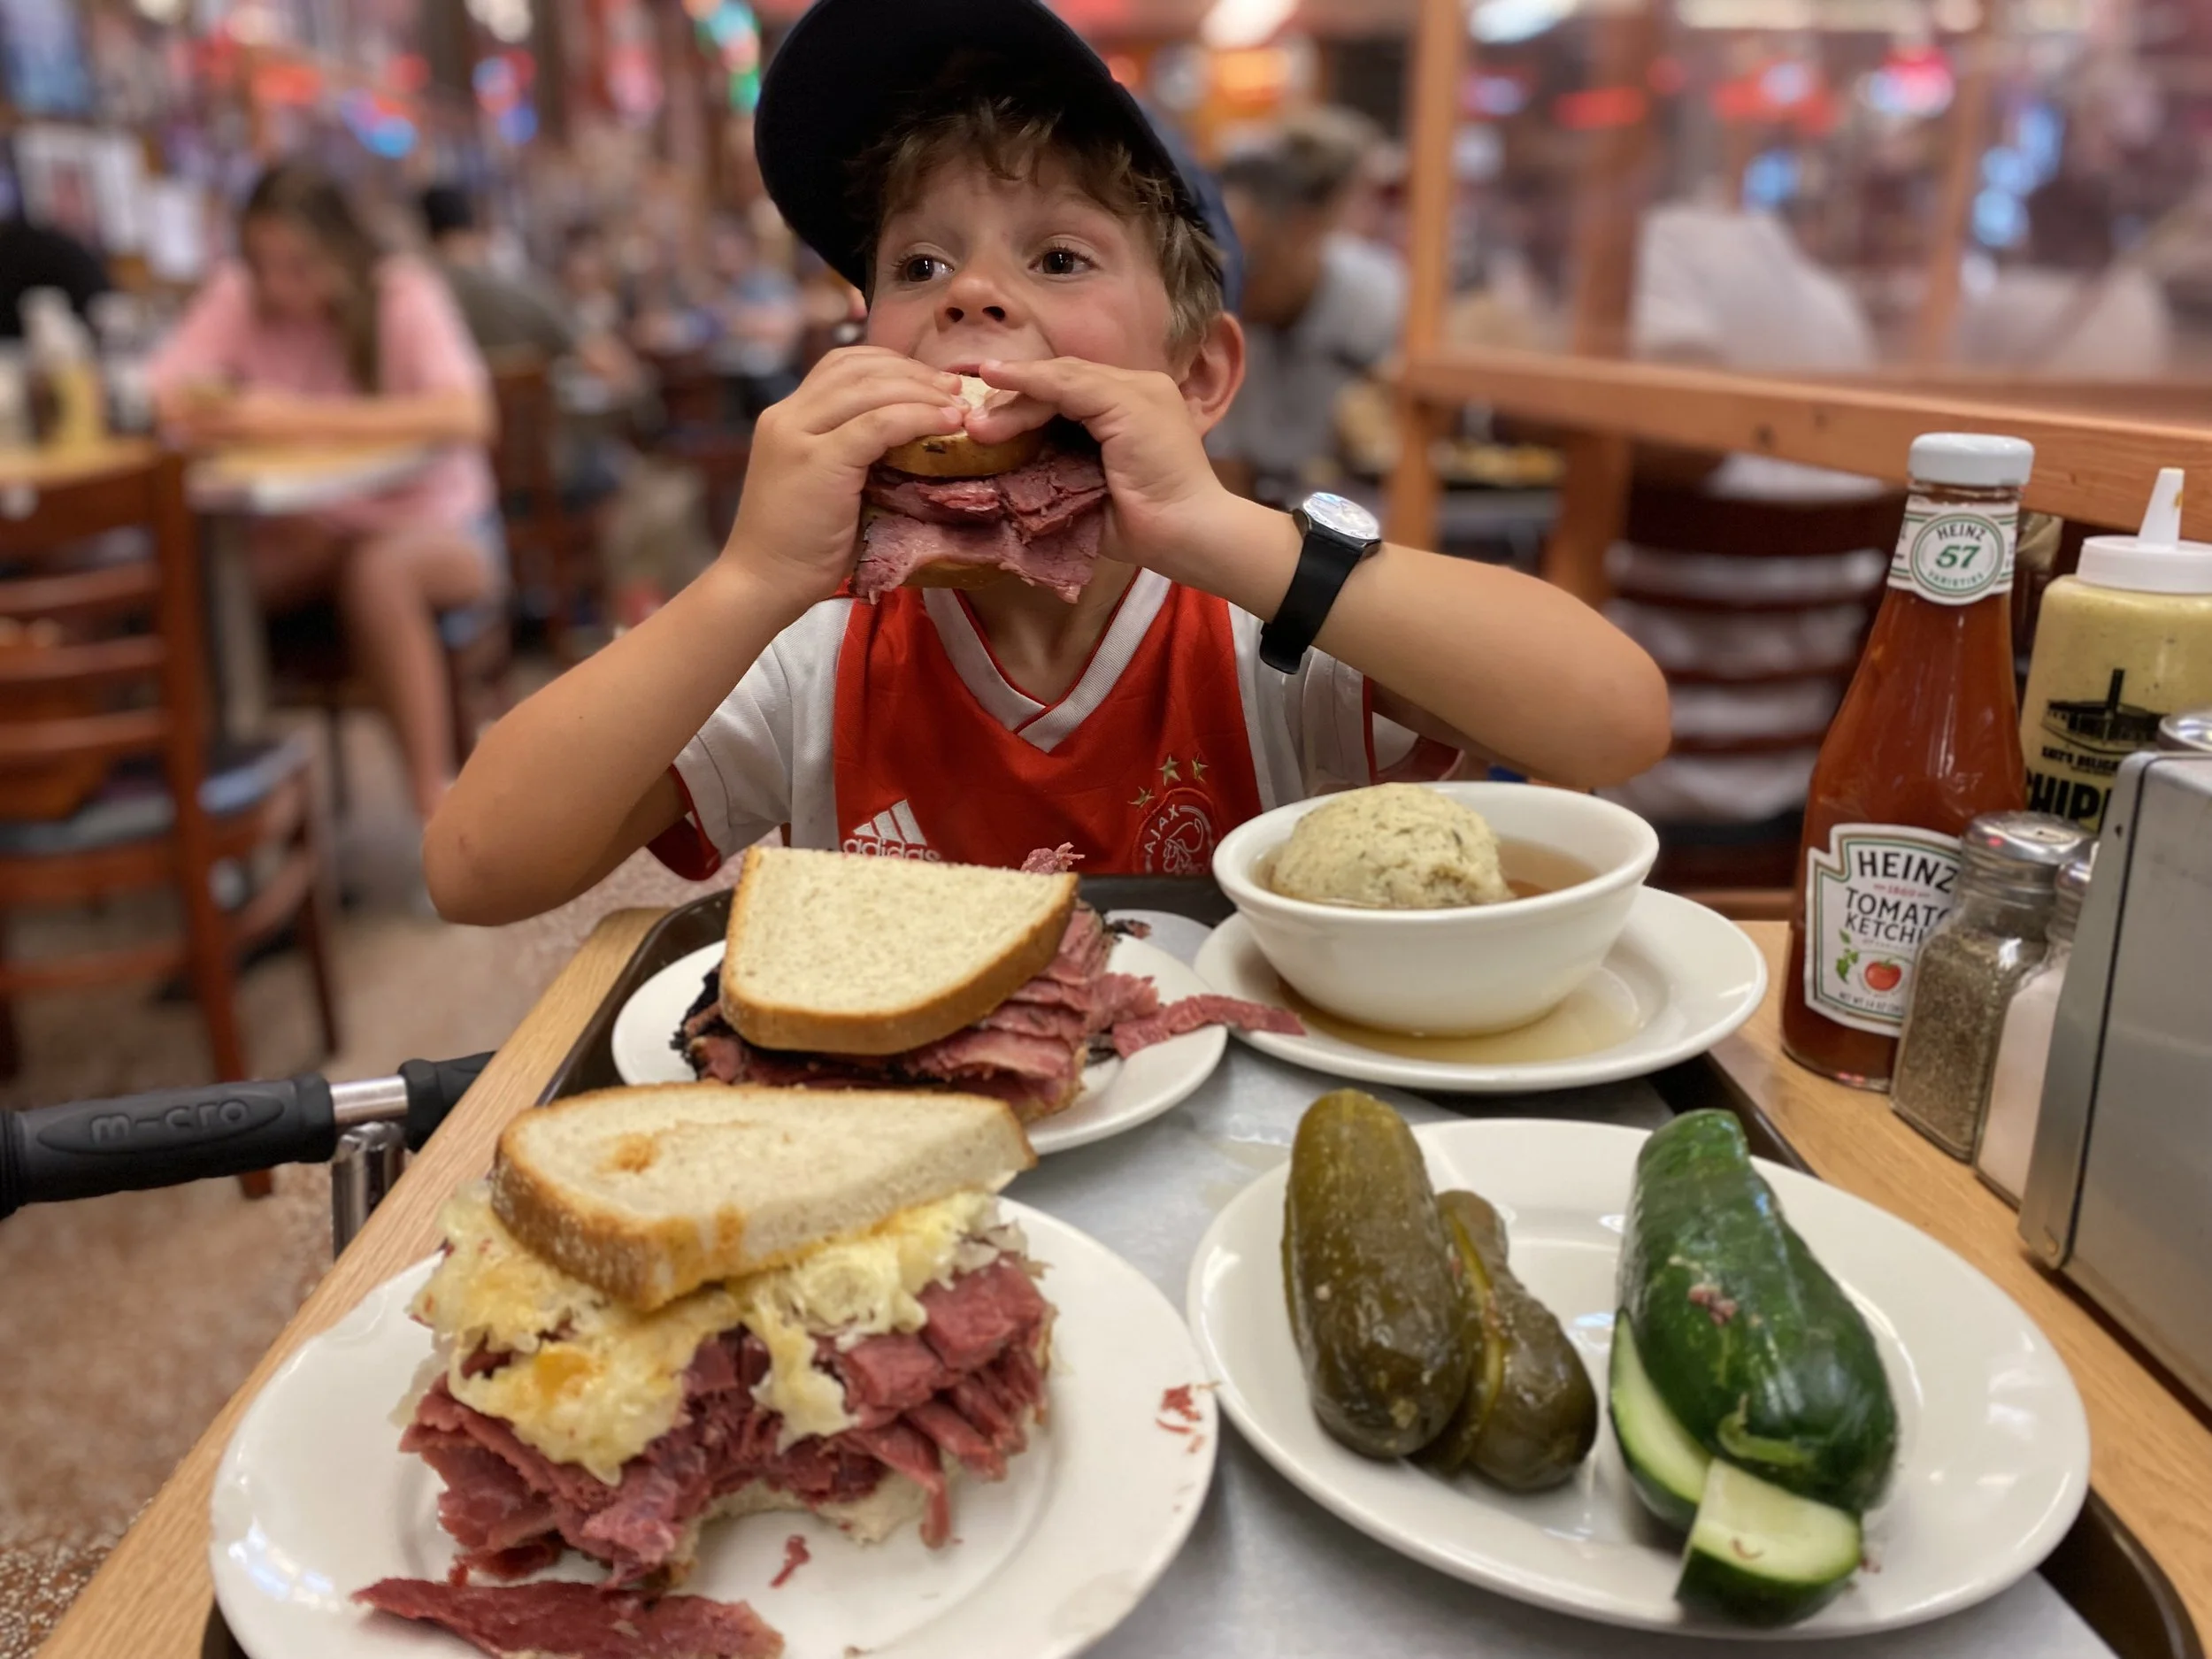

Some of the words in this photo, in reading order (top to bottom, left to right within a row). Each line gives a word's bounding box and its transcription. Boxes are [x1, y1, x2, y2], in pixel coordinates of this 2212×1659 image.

[1937, 524, 1986, 541] HEINZ
[1935, 544, 1981, 568] 57
[1144, 803, 1179, 854] AJAX
[1858, 849, 1960, 895] HEINZ
